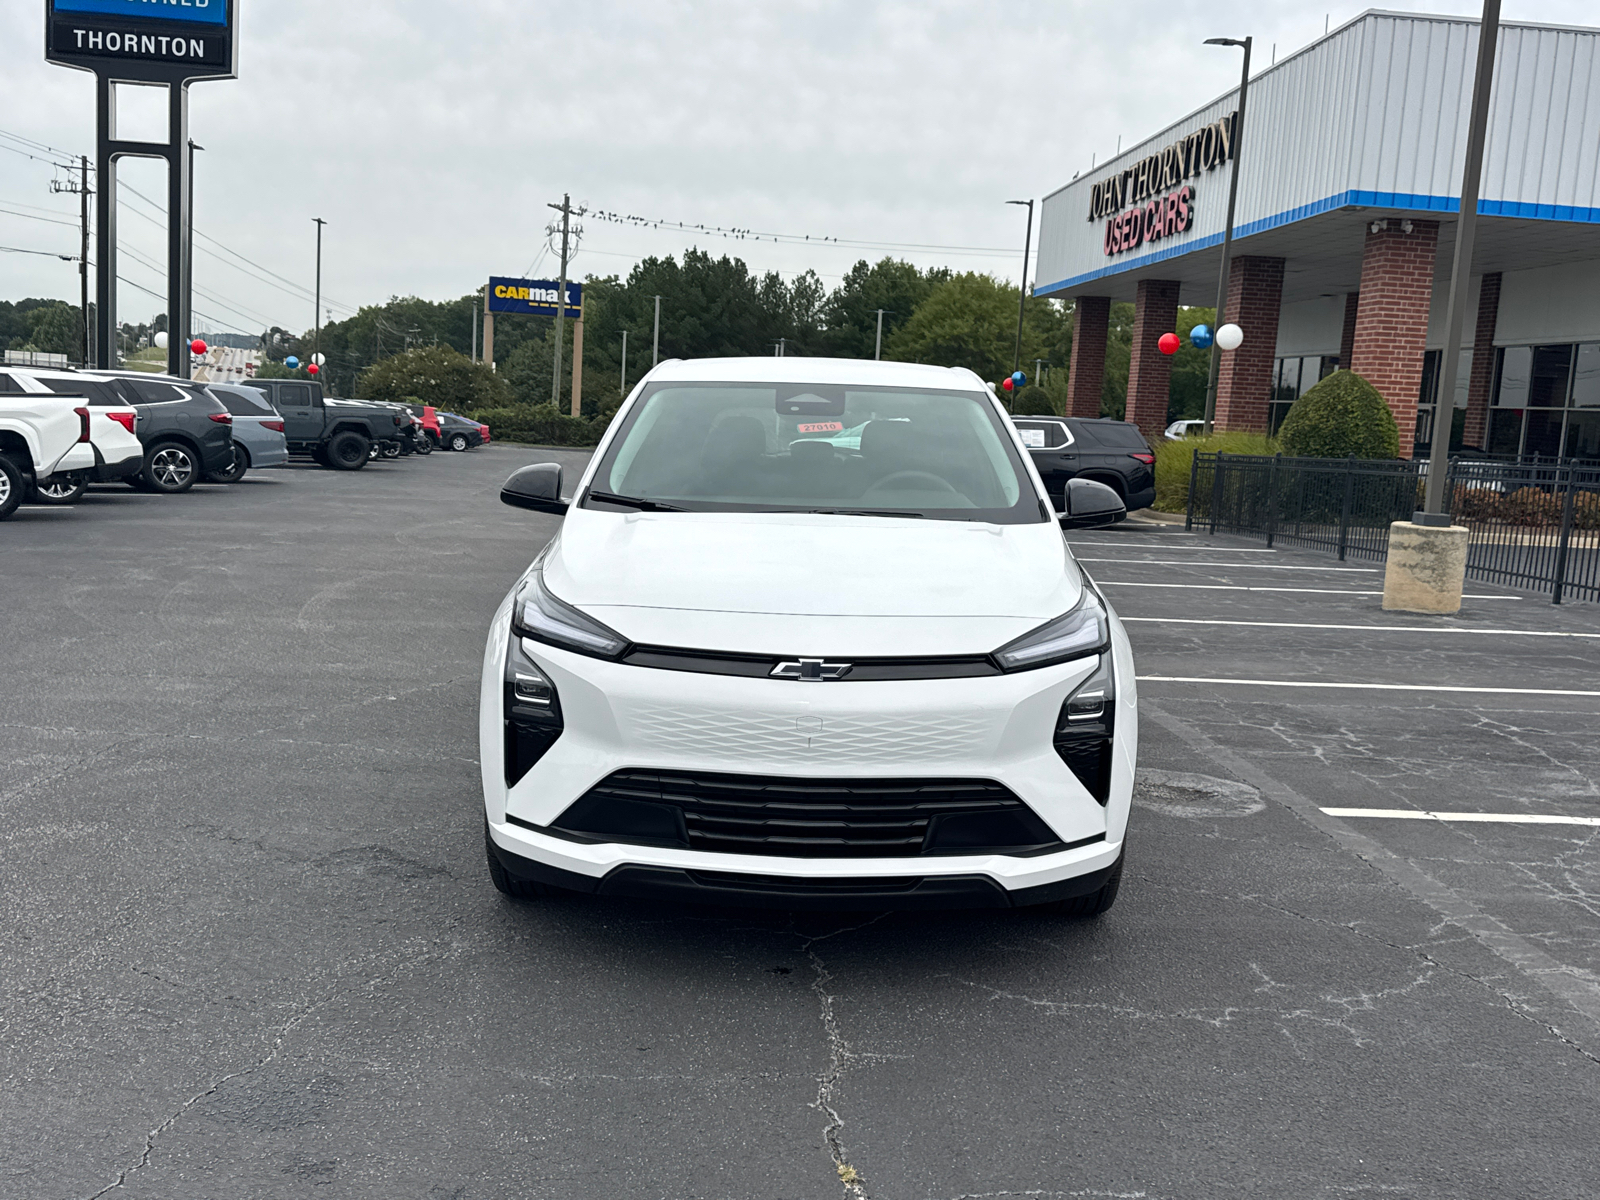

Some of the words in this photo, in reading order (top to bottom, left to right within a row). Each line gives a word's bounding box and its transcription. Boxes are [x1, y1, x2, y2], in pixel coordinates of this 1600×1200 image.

[73, 29, 204, 58] THORNTON
[1087, 171, 1129, 222] JOHN
[1128, 111, 1238, 204] THORNTON
[1104, 207, 1145, 256] USED
[1143, 186, 1195, 242] CARS
